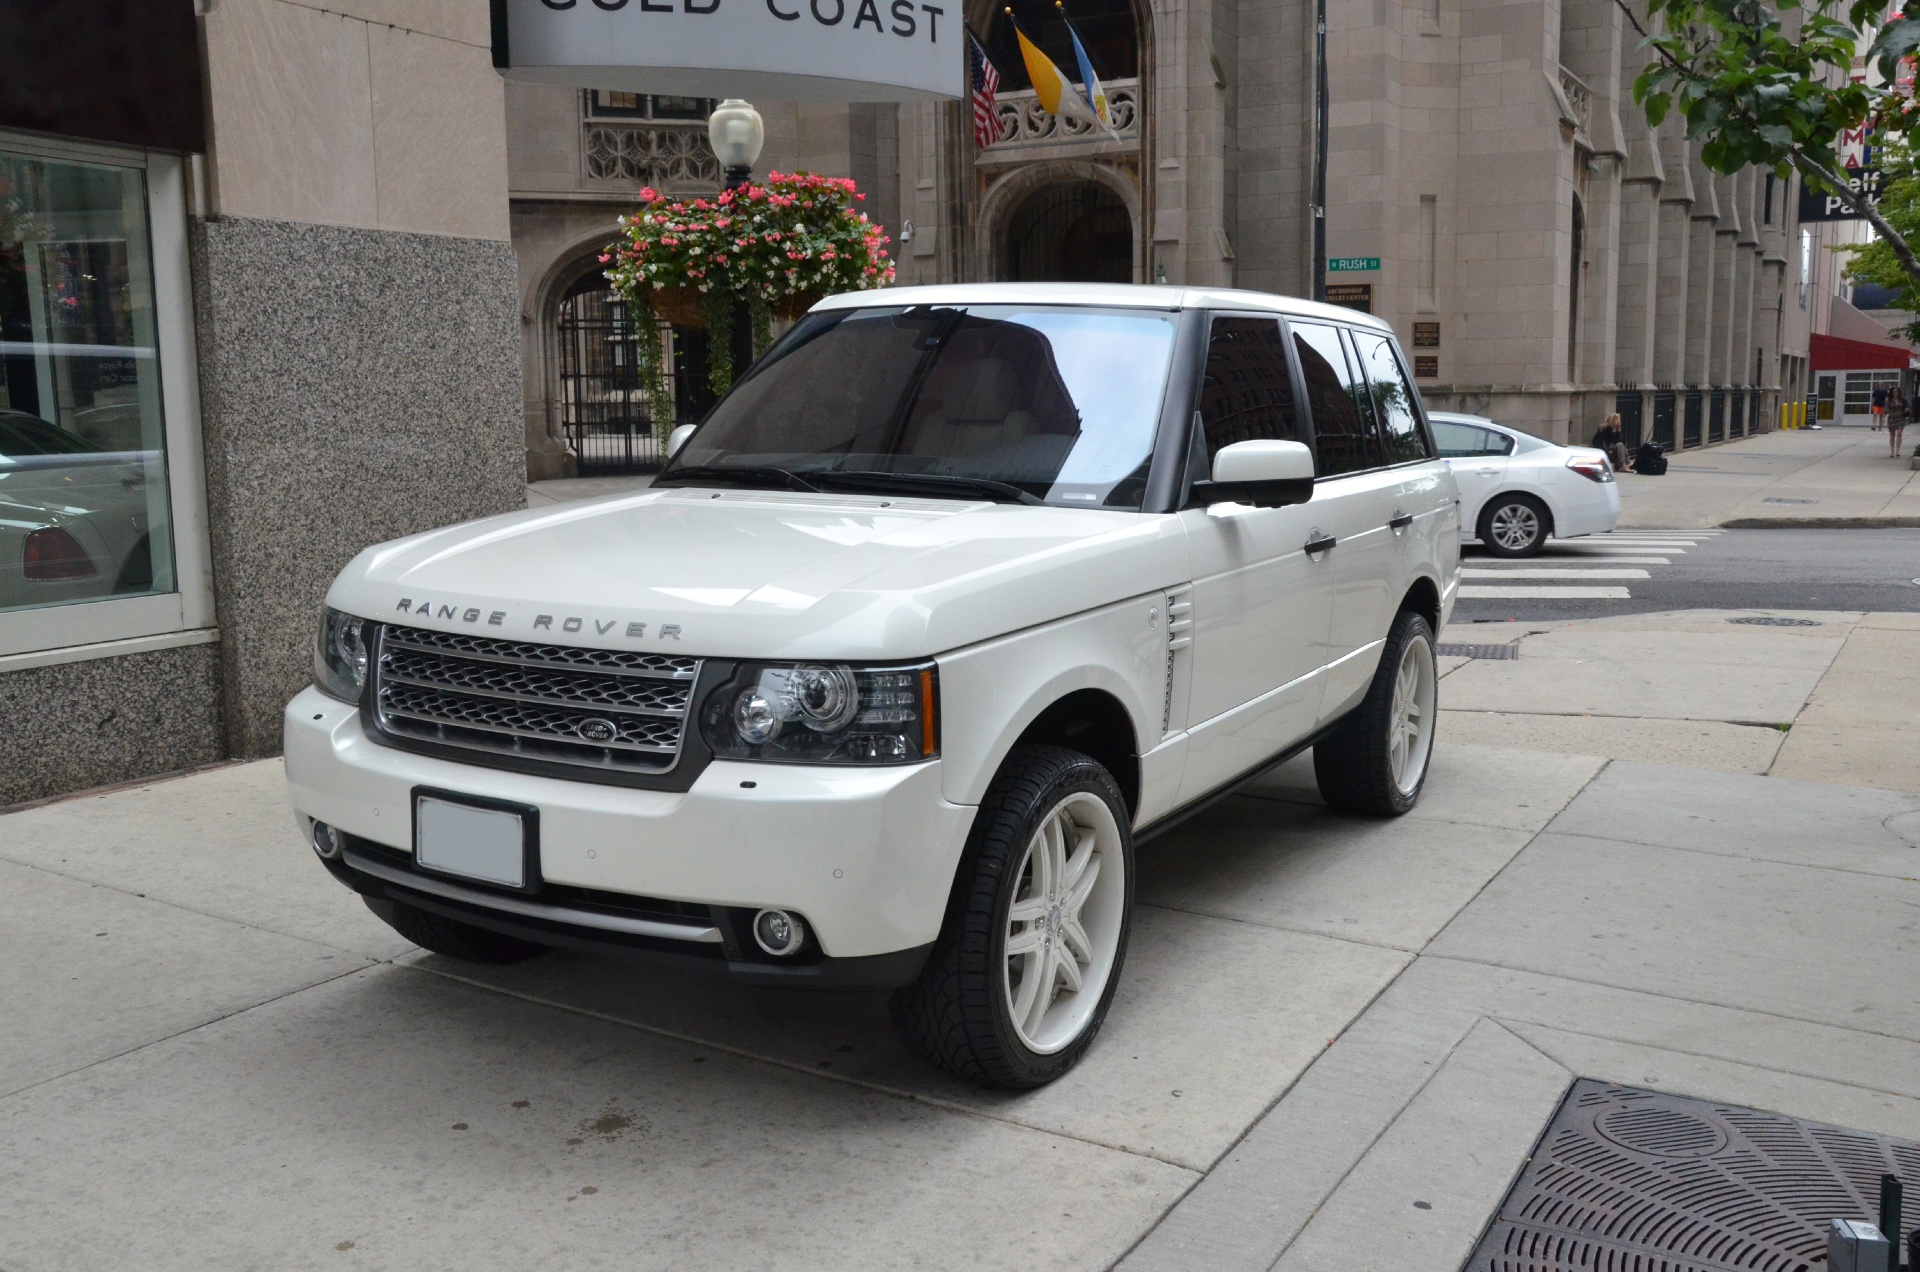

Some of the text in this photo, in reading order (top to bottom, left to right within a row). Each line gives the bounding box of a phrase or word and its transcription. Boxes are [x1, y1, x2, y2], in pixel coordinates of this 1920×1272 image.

[1848, 171, 1881, 194] elf
[1825, 192, 1882, 215] Pak
[1339, 259, 1367, 270] RUSH
[1327, 287, 1364, 295] ARCHBISHOP
[396, 597, 682, 640] RANGE ROVER
